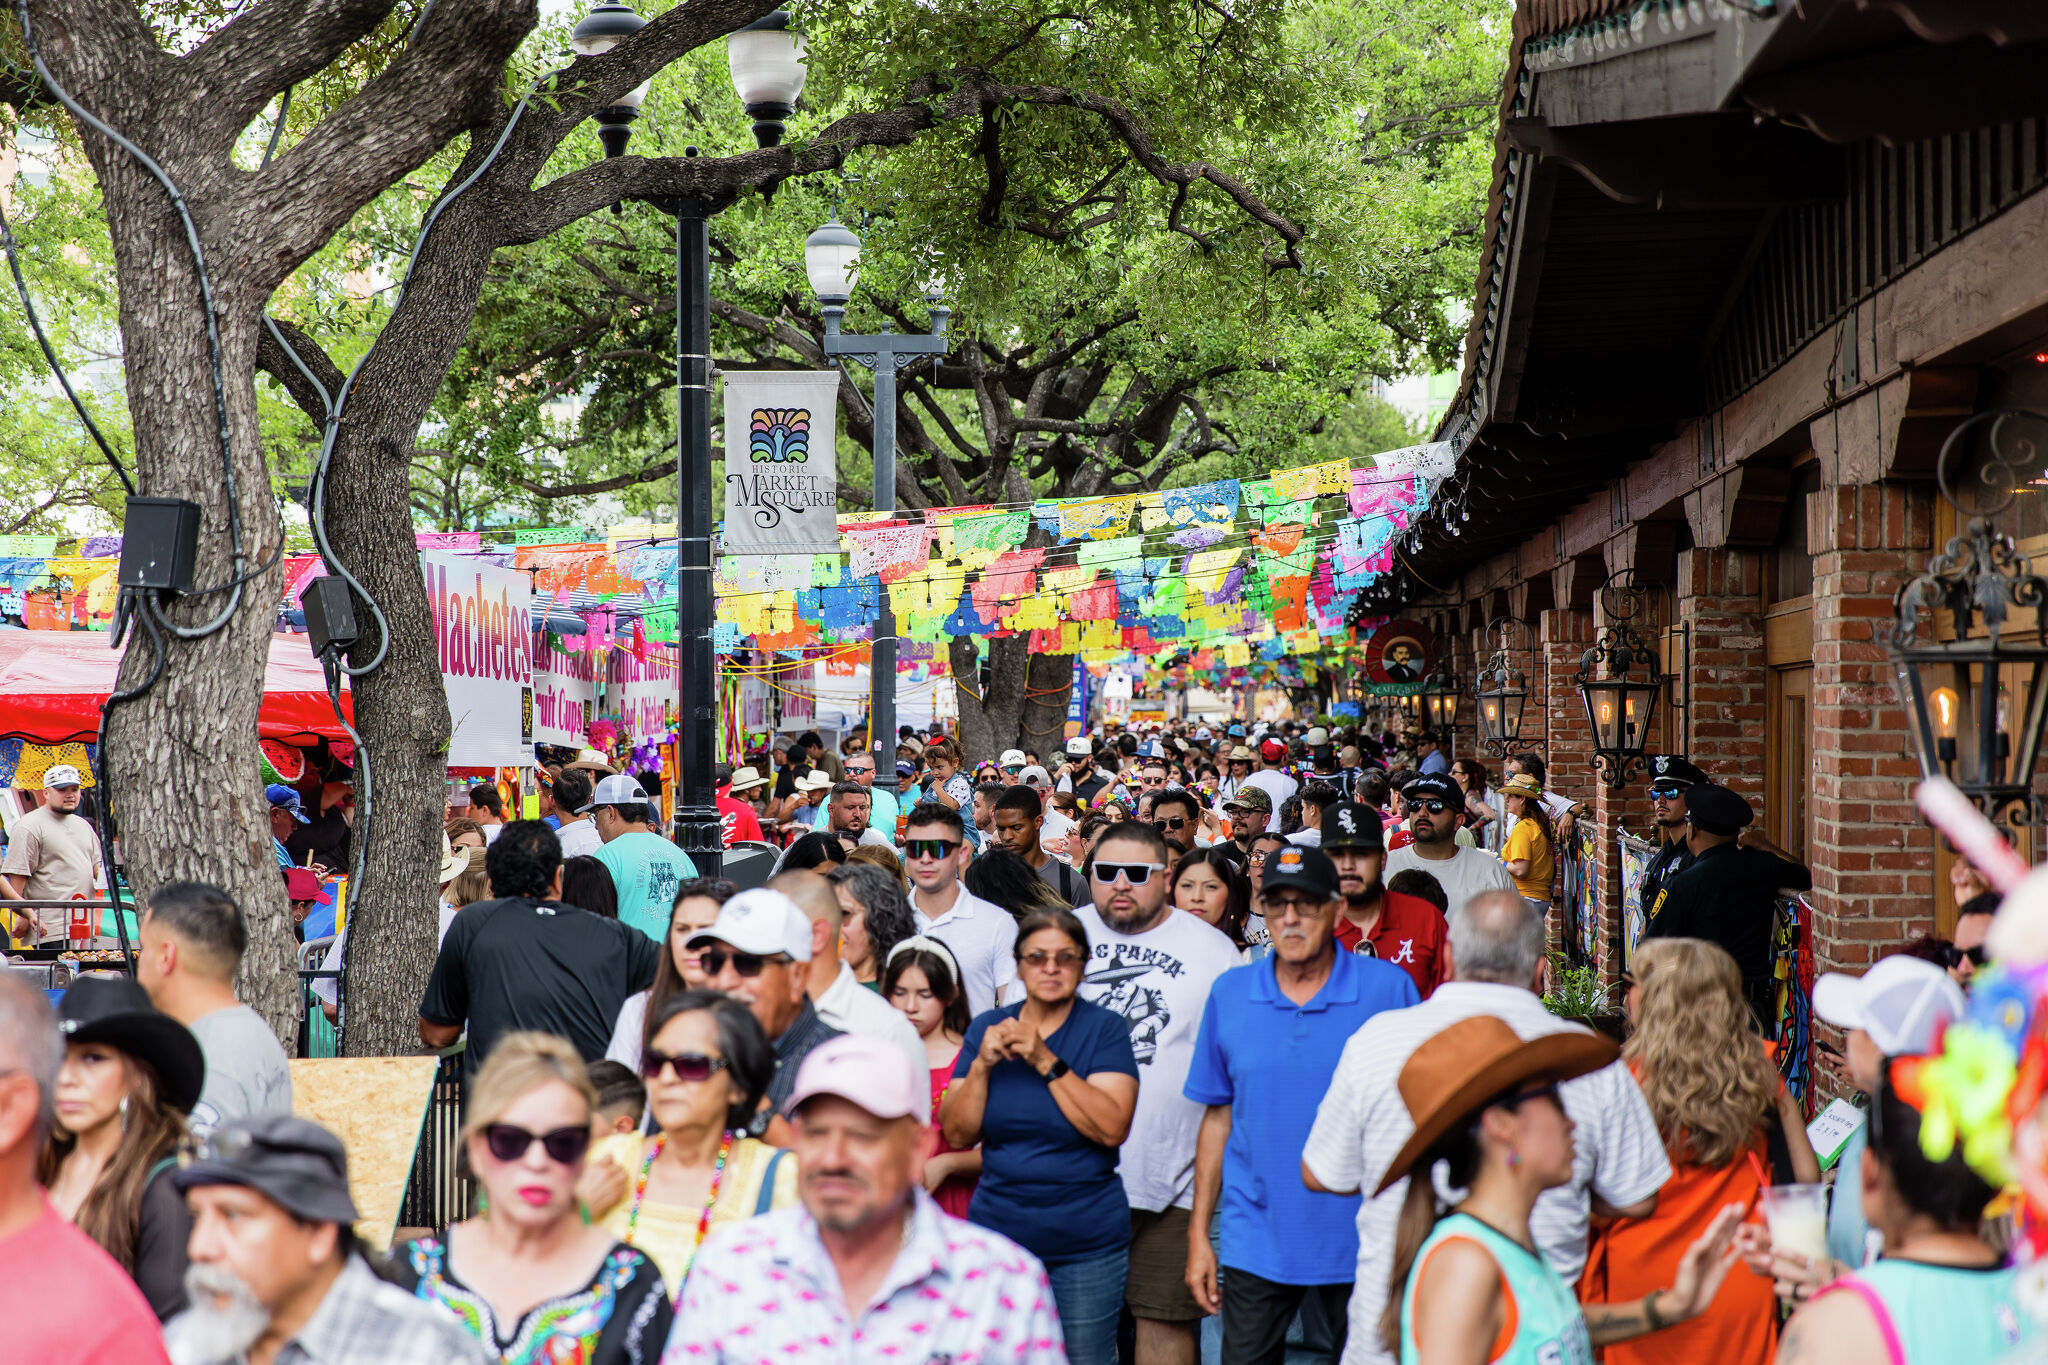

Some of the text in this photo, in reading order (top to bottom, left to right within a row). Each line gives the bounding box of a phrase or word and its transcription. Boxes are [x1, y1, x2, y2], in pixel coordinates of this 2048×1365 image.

[752, 465, 808, 474] HISTORIC
[726, 474, 818, 507] MARKET
[755, 491, 836, 529] SQUARE
[426, 561, 532, 684] Machetes
[558, 687, 583, 742] Cups
[1390, 938, 1416, 964] A
